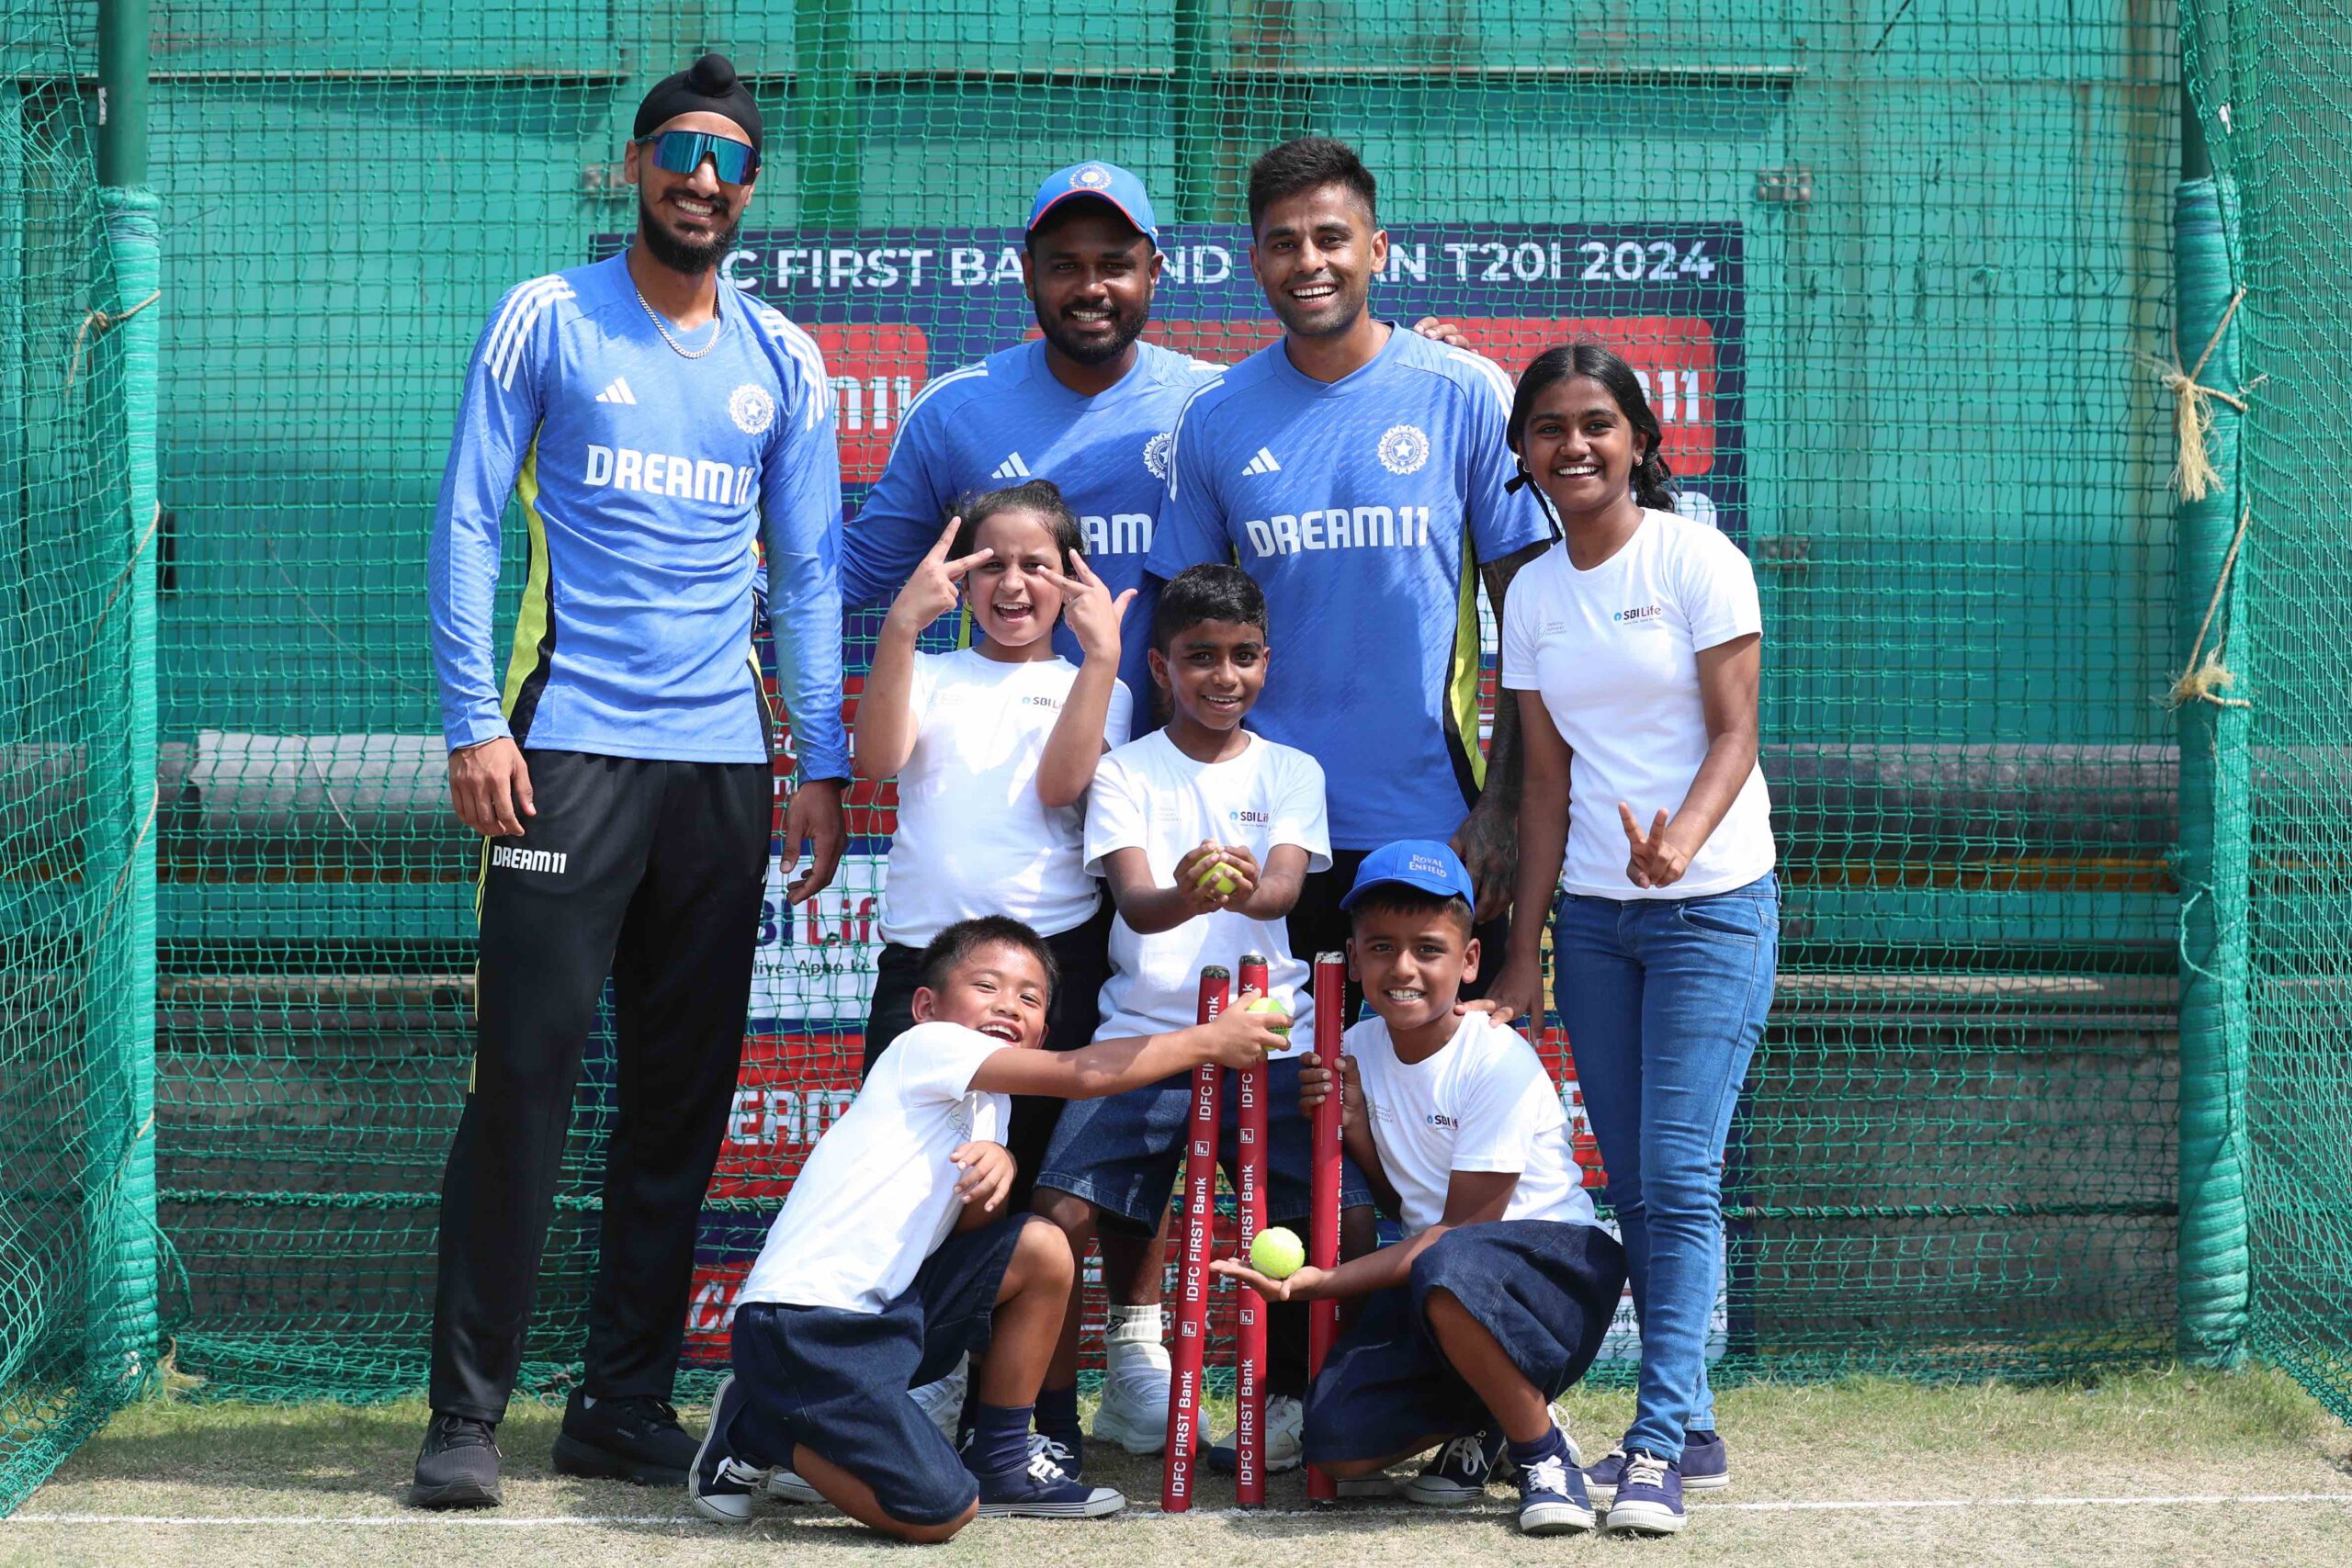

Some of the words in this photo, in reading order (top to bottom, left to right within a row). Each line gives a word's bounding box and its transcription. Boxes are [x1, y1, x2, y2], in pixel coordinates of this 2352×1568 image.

[777, 248, 933, 288] FIRST
[1579, 241, 1715, 281] 2024
[583, 445, 755, 505] DREAM11
[1246, 506, 1429, 558] DREAM11
[1623, 608, 1640, 620] SBI
[1641, 605, 1661, 617] Life
[1033, 697, 1051, 707] SBI
[1240, 811, 1256, 822] SBI
[492, 845, 567, 874] DREAM11
[1408, 861, 1448, 878] ENFIELD
[1412, 854, 1444, 868] ROYAL
[807, 897, 886, 946] Lif
[1199, 1085, 1213, 1121] IDFC
[1242, 1073, 1253, 1108] IDFC
[1193, 1177, 1207, 1214] Bank
[1242, 1164, 1253, 1201] Bank
[1189, 1217, 1204, 1262] FIRST
[1241, 1208, 1253, 1249] FIRST
[1186, 1266, 1200, 1302] IDFC
[1179, 1371, 1193, 1409] Bank
[1241, 1359, 1253, 1396] Bank
[1175, 1413, 1190, 1457] FIRST
[1240, 1401, 1252, 1445] FIRST
[1172, 1461, 1186, 1497] IDFC
[1240, 1451, 1252, 1485] IDFC
